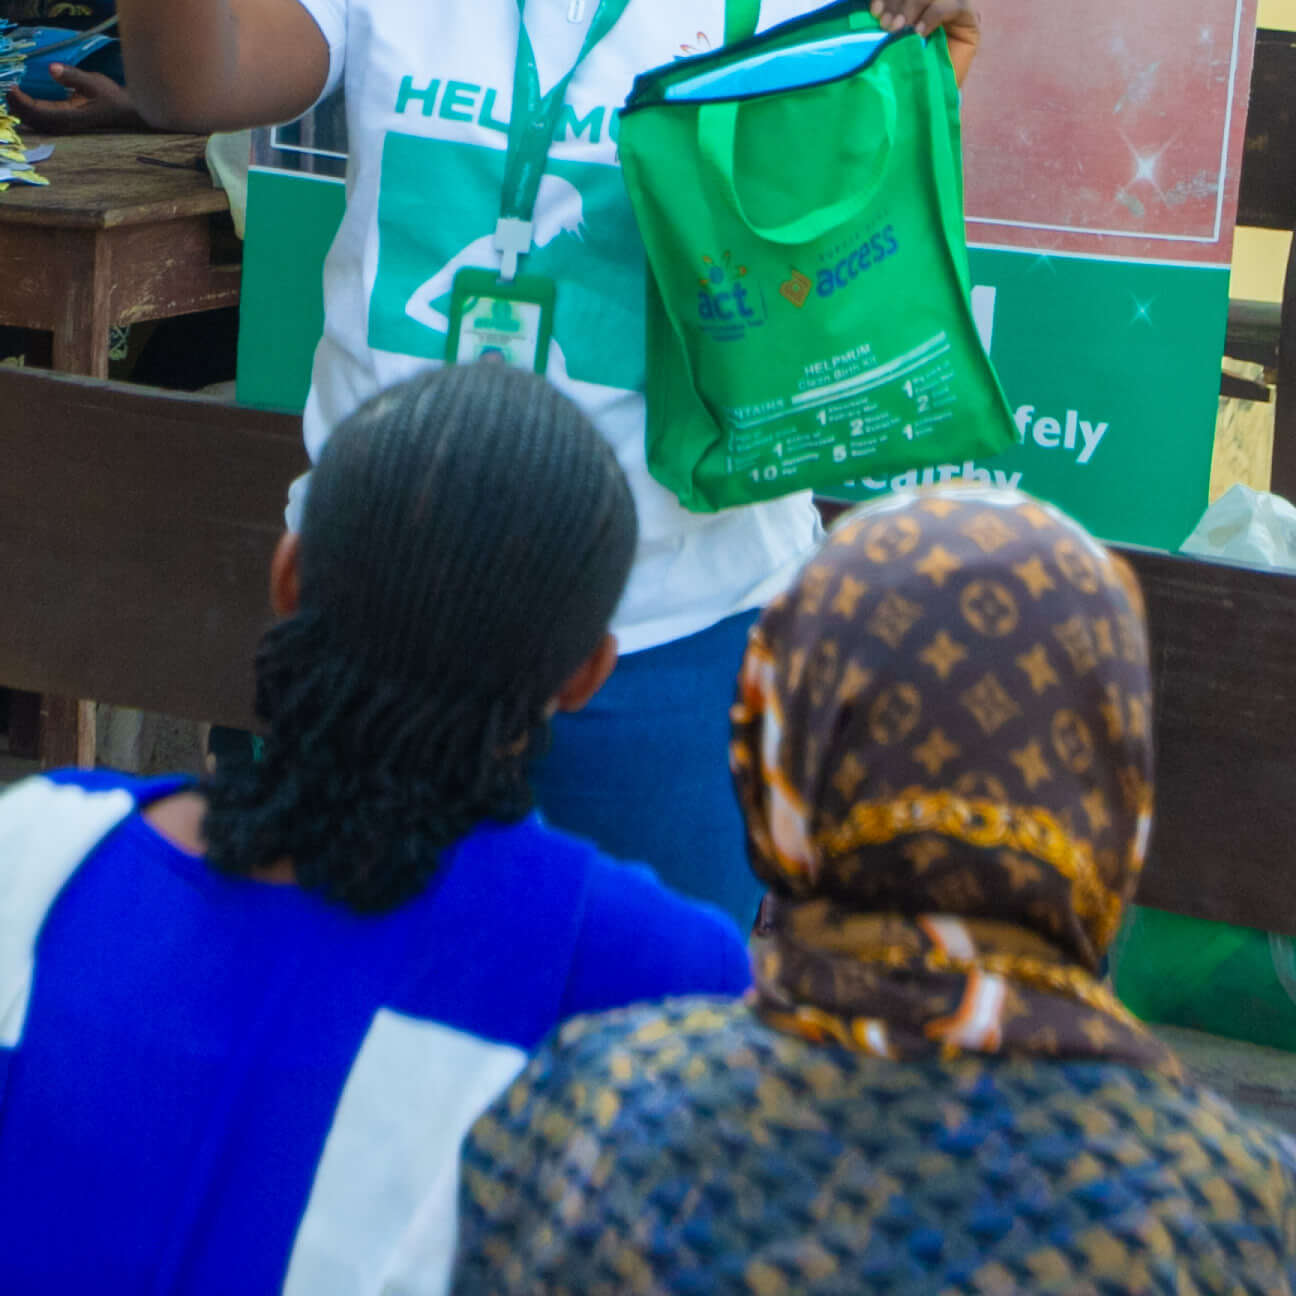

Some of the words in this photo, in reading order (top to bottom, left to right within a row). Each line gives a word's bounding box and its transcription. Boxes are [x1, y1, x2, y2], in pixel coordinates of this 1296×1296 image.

[816, 224, 899, 298] access
[697, 282, 754, 320] act
[816, 409, 827, 425] 1
[917, 394, 929, 413] 2
[850, 418, 864, 436] 2
[1013, 405, 1109, 464] fely
